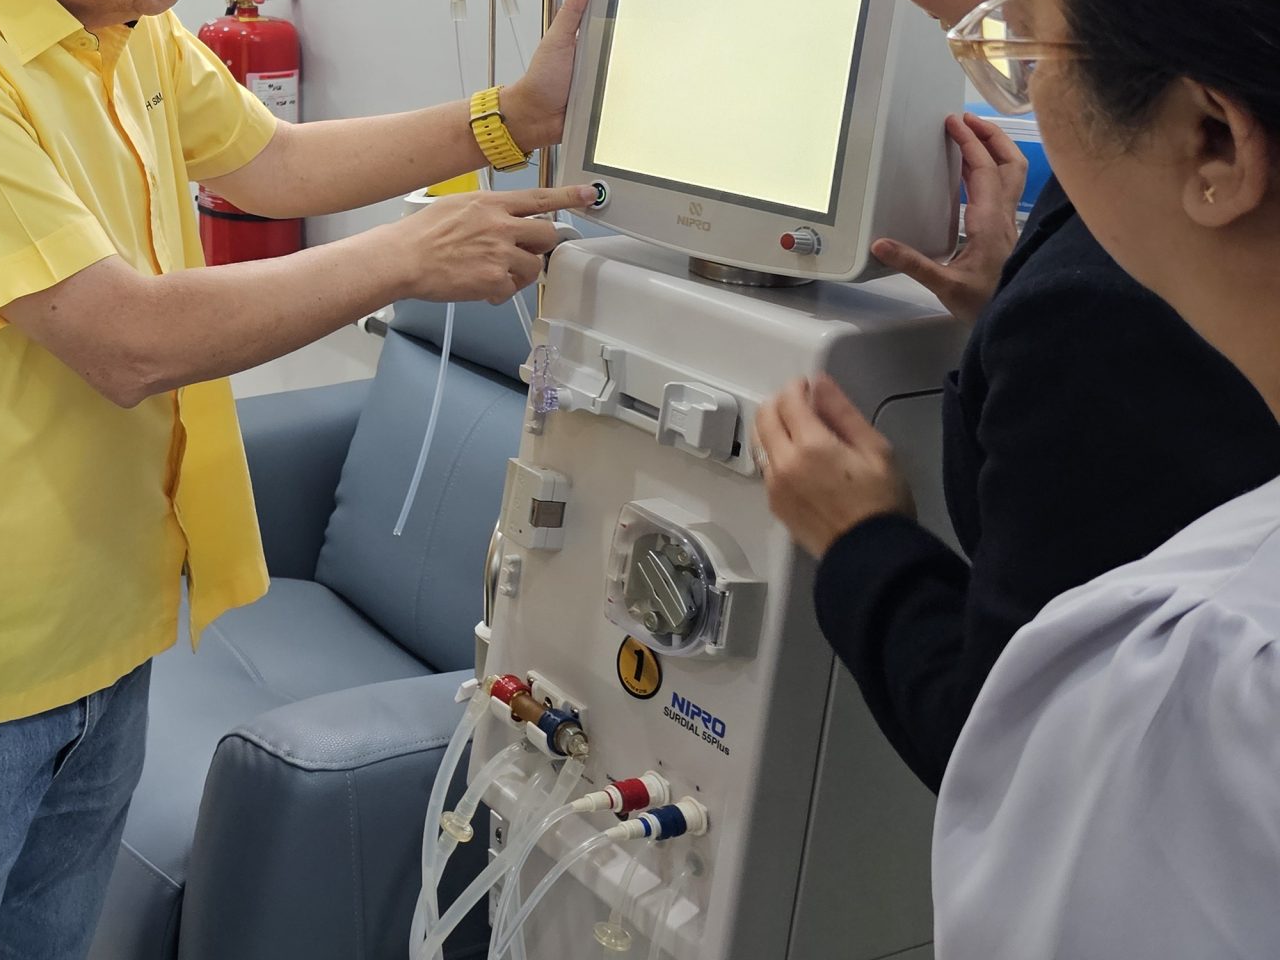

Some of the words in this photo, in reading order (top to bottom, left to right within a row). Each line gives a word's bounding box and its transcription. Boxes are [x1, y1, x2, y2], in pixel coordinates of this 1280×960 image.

[676, 215, 711, 232] NIPRO
[634, 649, 644, 682] 1
[663, 706, 700, 737] SURDIAL
[671, 691, 726, 739] NIPRO
